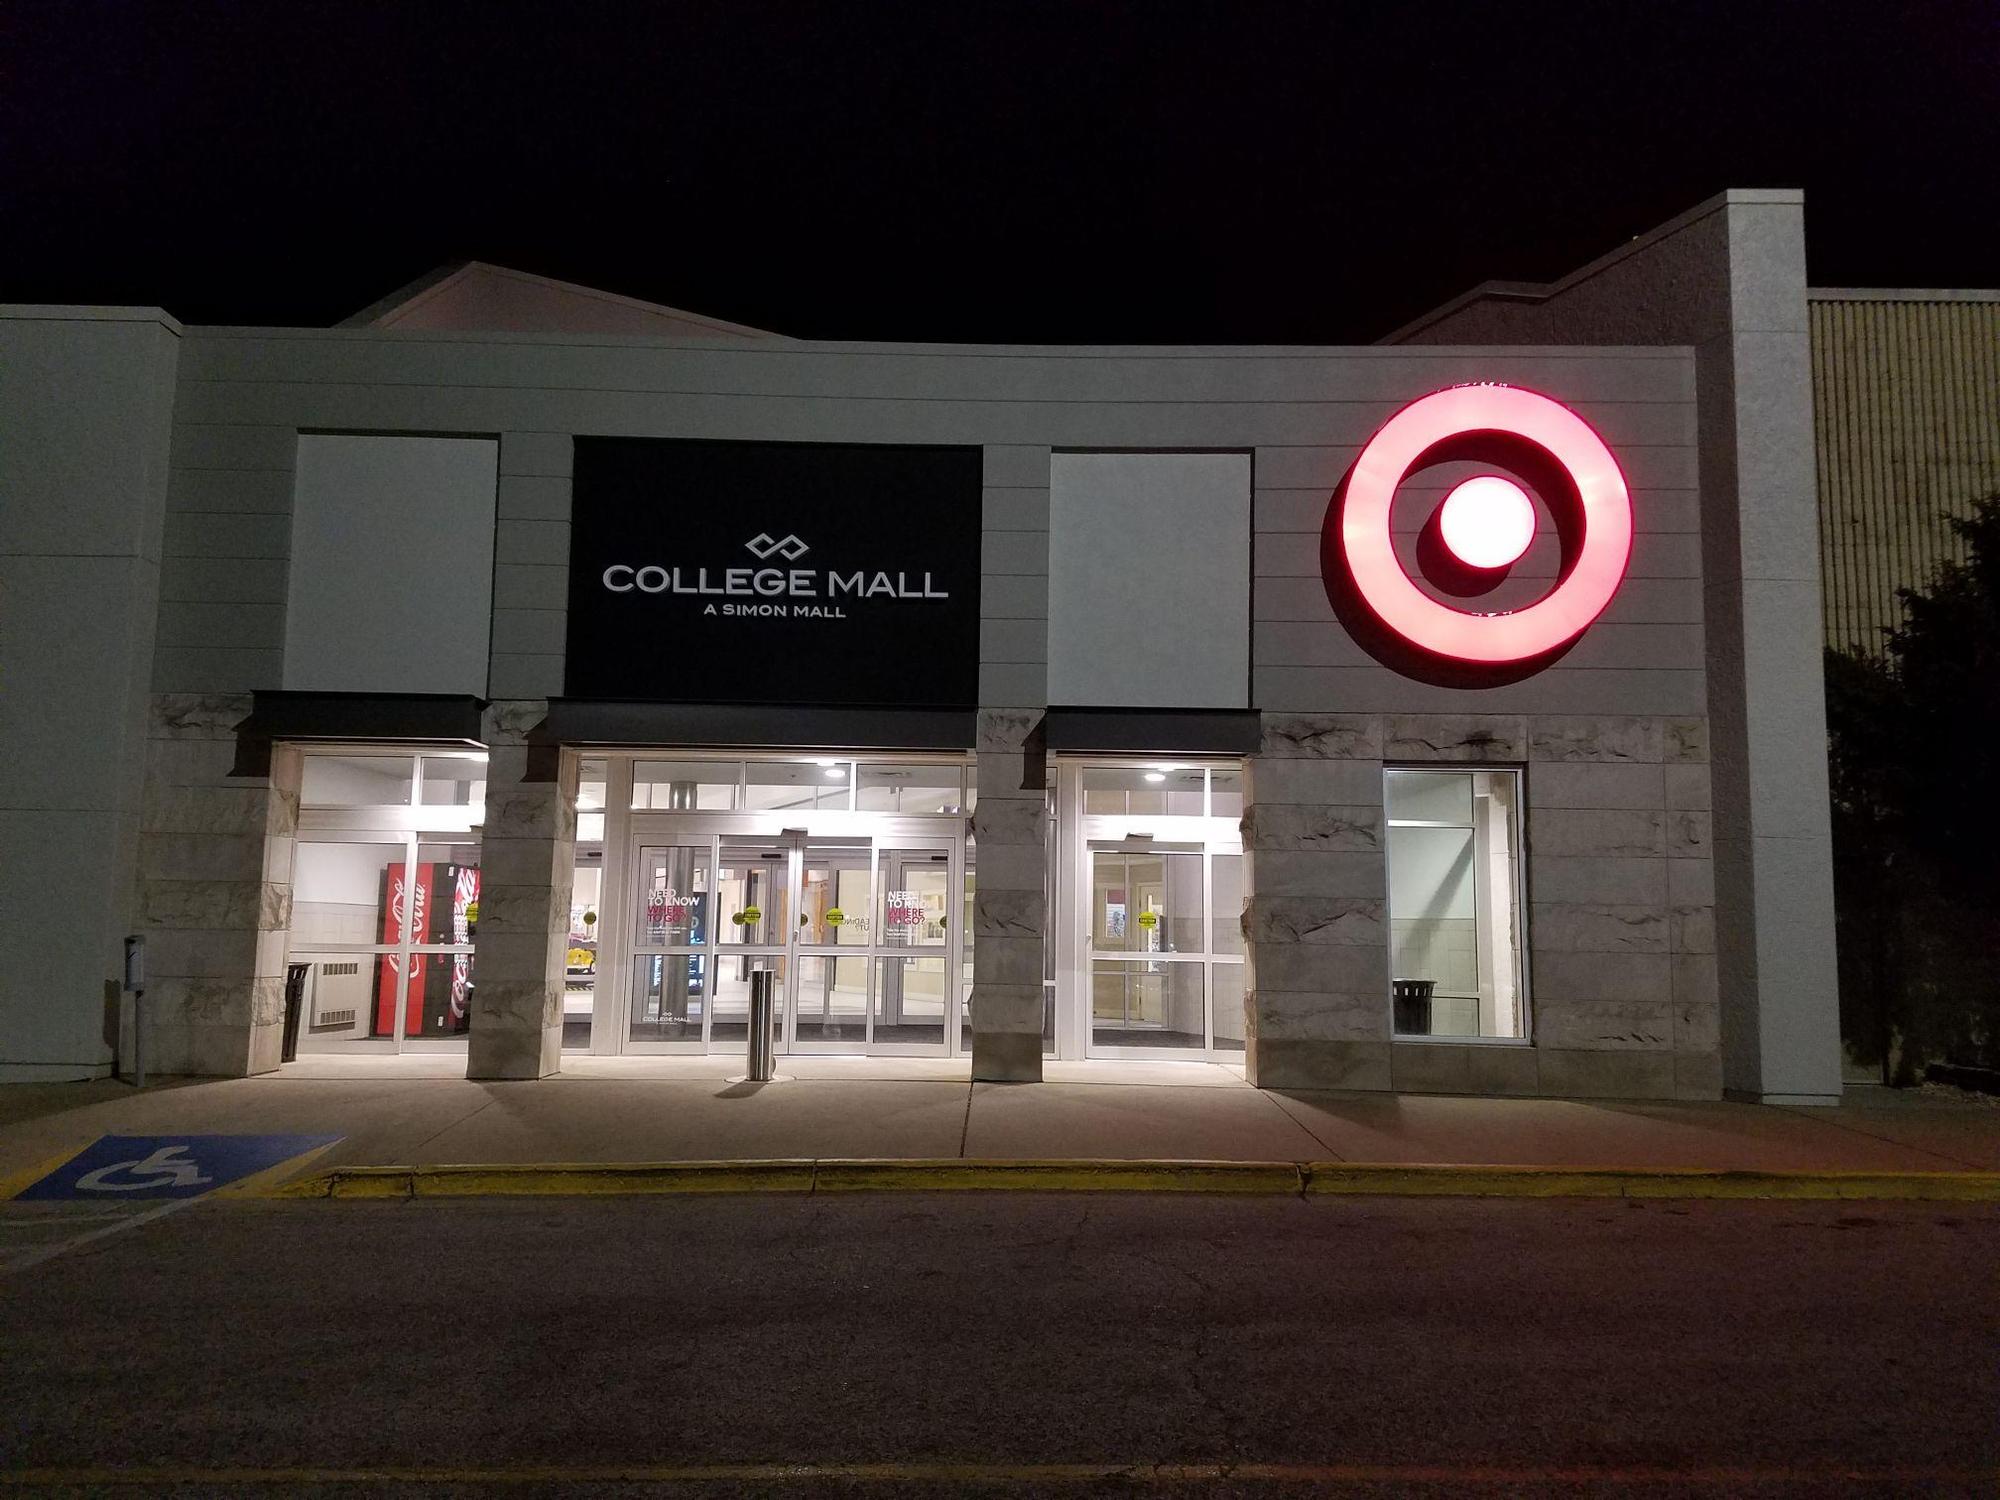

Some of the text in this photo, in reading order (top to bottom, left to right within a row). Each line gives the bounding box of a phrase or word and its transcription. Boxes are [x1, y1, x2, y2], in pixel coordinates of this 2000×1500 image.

[602, 564, 949, 598] COLLEGE MALL
[703, 604, 847, 619] A SIMON MALL
[648, 889, 677, 898] NEED
[648, 897, 700, 906] TO KNOW
[889, 900, 902, 909] TO
[648, 906, 686, 914] WHERE
[888, 908, 925, 917] WHERE
[648, 914, 662, 922] TO
[888, 917, 926, 925] TO GO?
